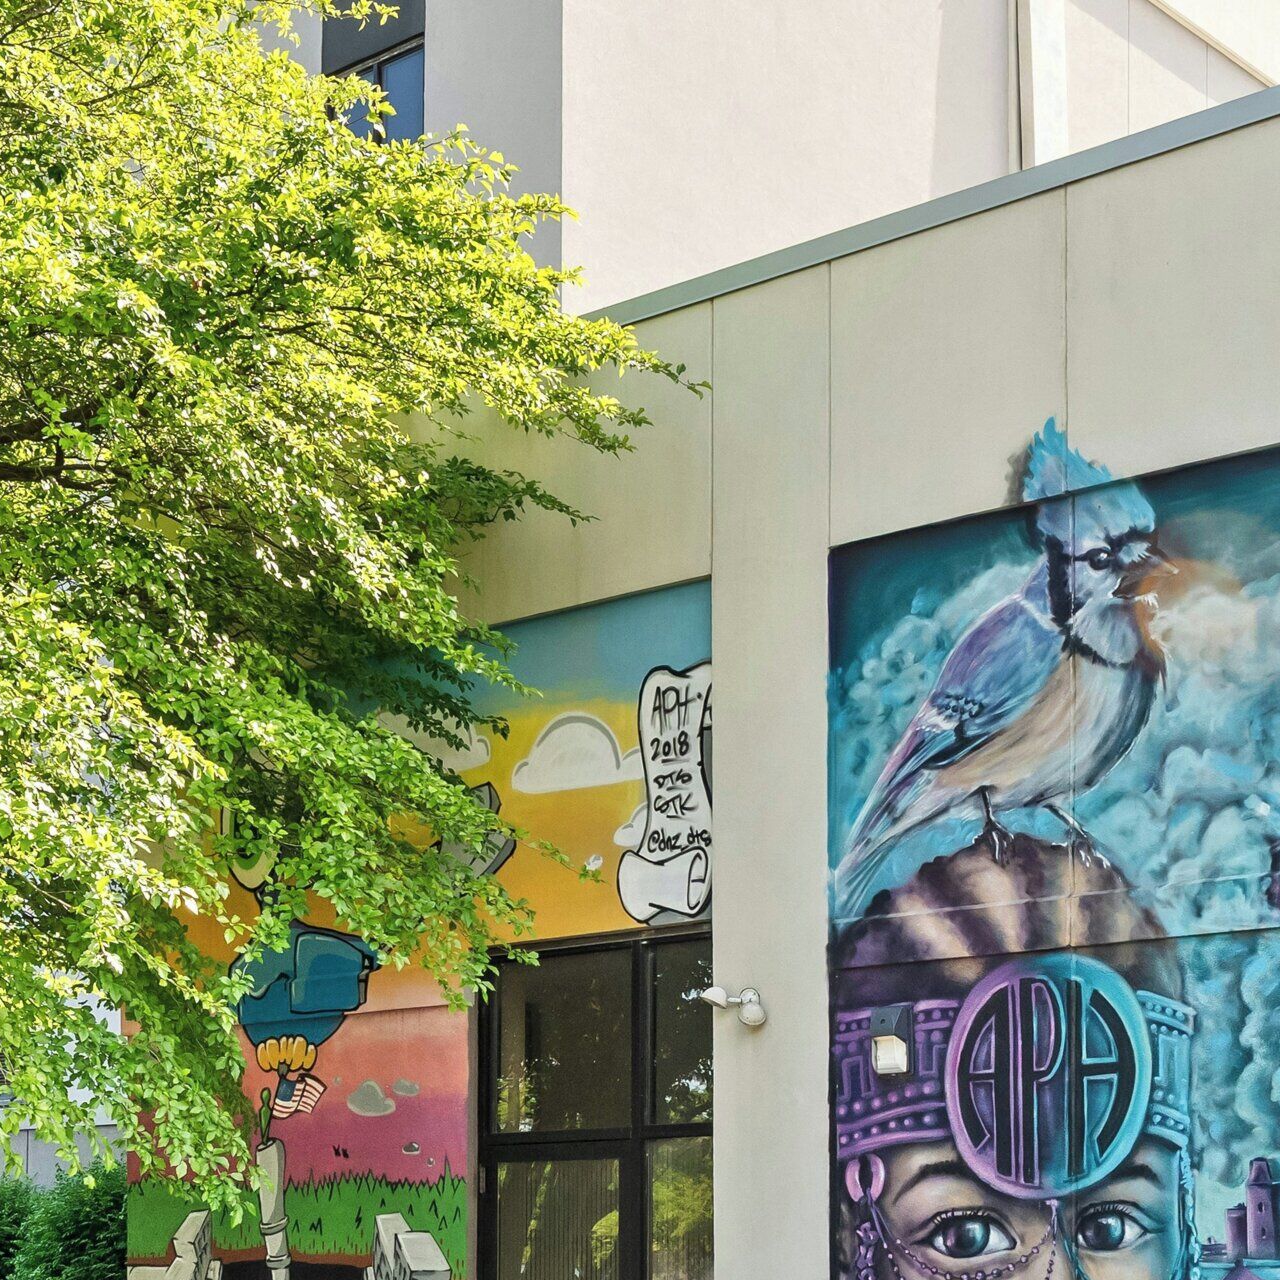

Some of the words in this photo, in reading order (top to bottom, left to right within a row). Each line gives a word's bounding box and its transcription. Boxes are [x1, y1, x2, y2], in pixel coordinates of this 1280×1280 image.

[651, 684, 697, 735] APH
[650, 731, 690, 760] 2018
[654, 792, 699, 816] STK
[957, 976, 1136, 1186] APH
